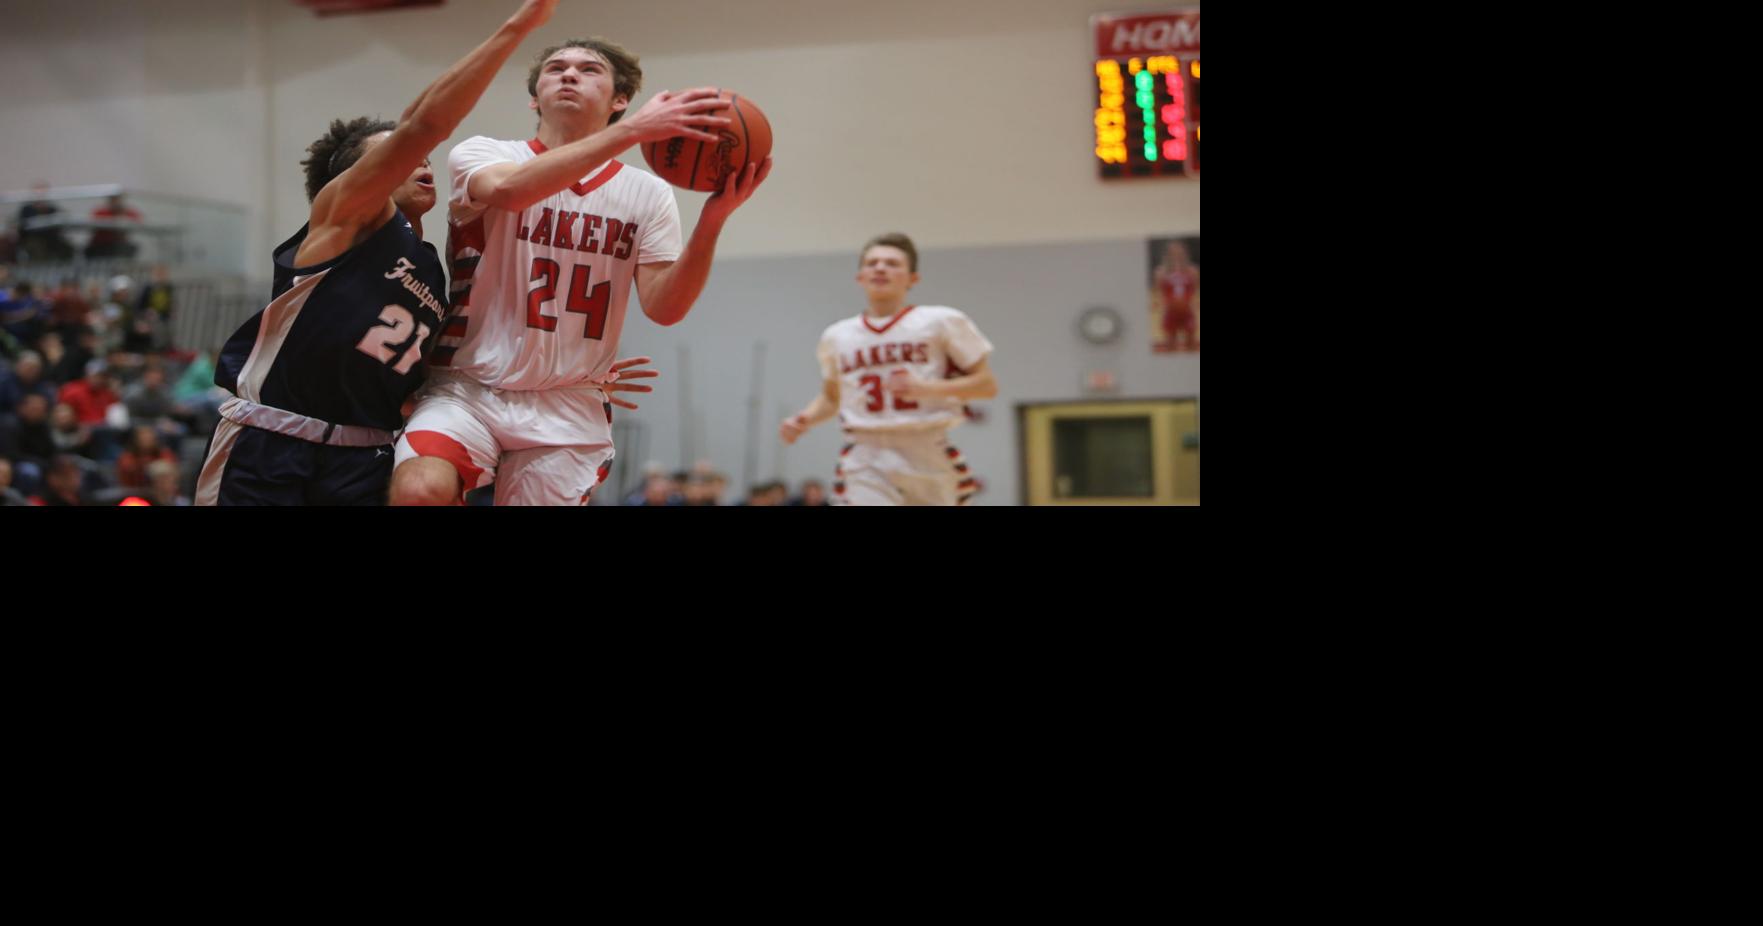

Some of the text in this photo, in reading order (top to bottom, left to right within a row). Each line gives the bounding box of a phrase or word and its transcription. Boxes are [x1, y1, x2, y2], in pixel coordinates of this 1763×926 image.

[516, 207, 638, 260] LAKERS
[527, 257, 611, 340] 24
[354, 303, 430, 375] 21
[841, 343, 928, 374] LAKERS
